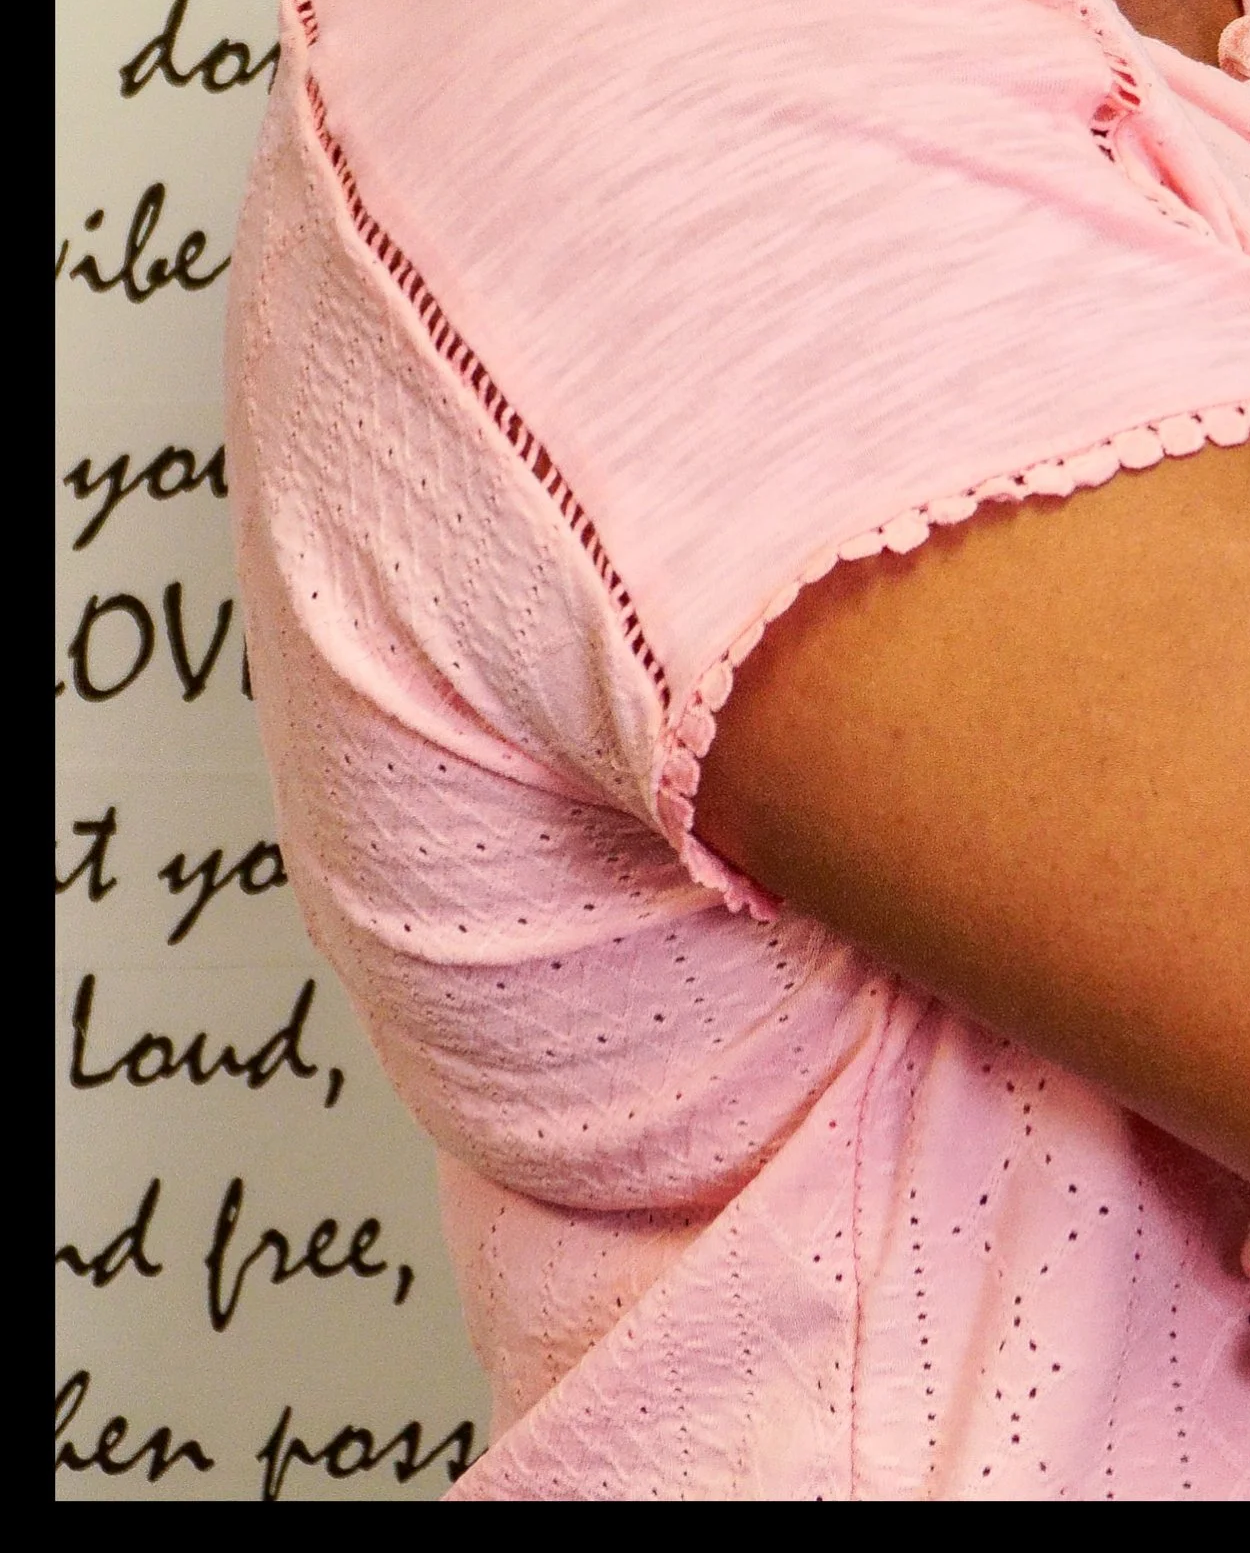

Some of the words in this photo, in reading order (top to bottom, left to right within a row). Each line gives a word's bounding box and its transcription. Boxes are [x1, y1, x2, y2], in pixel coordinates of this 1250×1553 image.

[55, 182, 231, 304] ibe
[55, 581, 253, 703] OV
[69, 973, 344, 1108] Loud,
[204, 1177, 415, 1333] free,
[255, 1405, 488, 1500] poss
